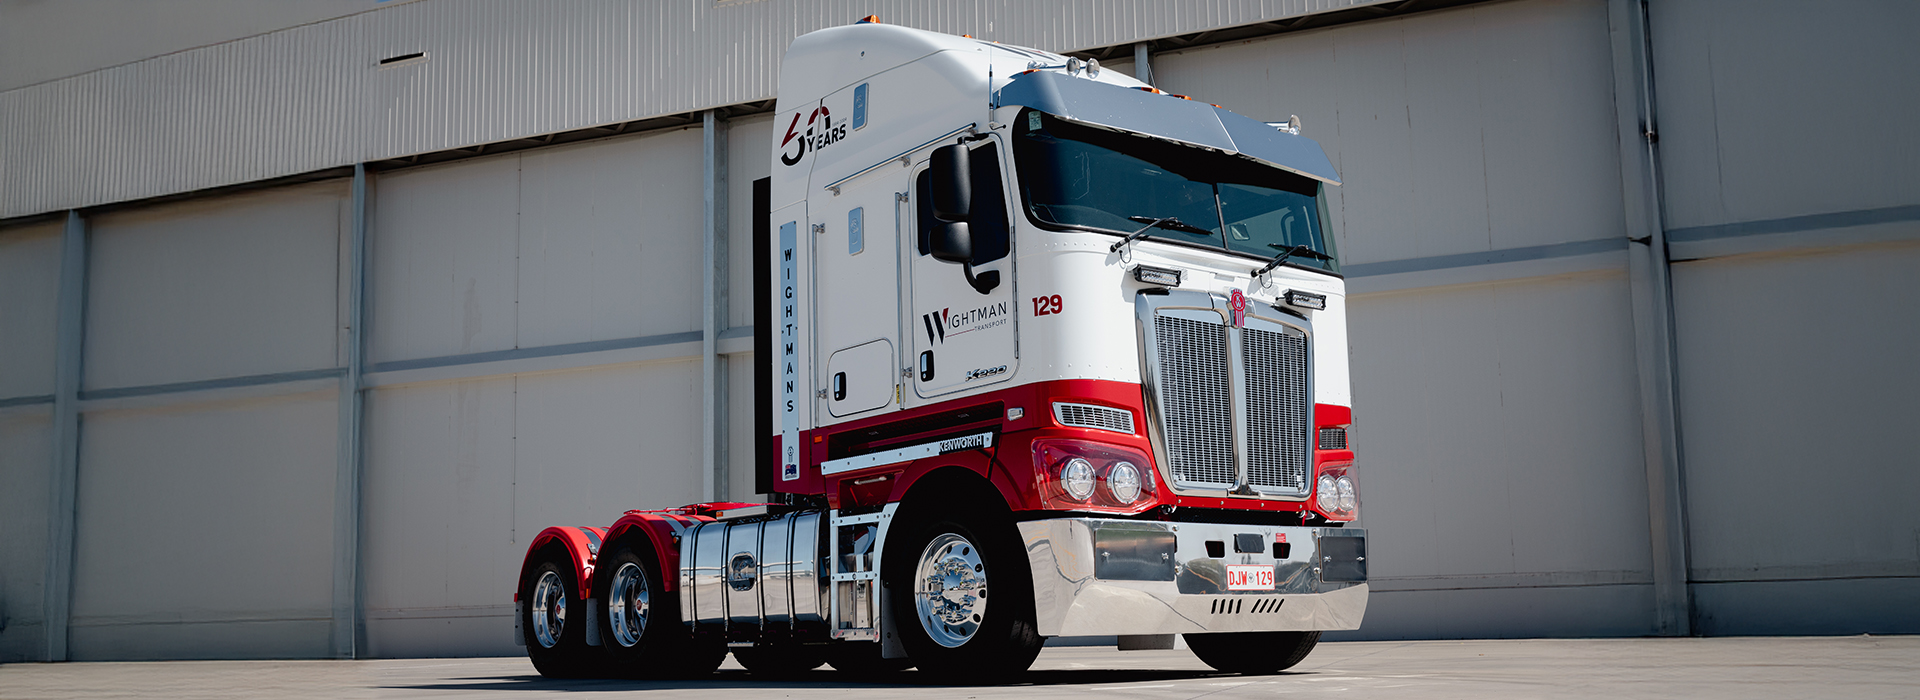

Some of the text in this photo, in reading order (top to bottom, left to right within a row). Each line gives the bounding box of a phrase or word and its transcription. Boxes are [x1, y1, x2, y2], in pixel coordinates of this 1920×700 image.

[780, 105, 831, 166] 60
[806, 123, 847, 153] YEARS
[1032, 294, 1063, 317] 129
[784, 248, 794, 412] WIGHTMANS
[923, 301, 1007, 347] WIGHTMAN
[974, 318, 1007, 332] TRANSPORT
[939, 434, 983, 452] KENWORTH
[1229, 570, 1273, 586] DJW 129
